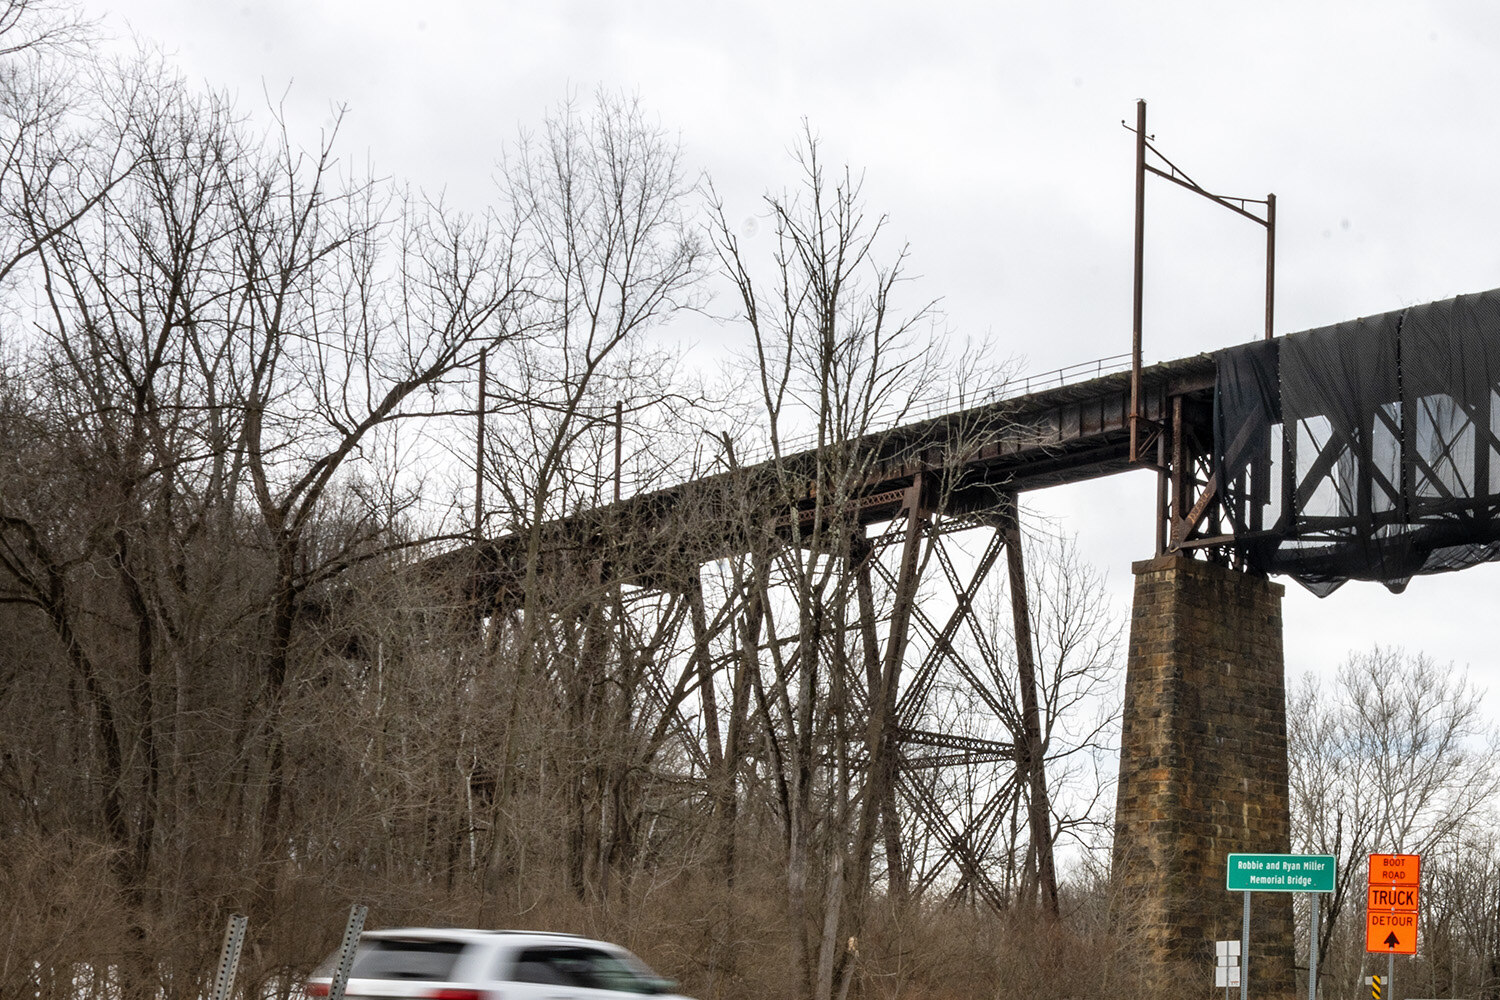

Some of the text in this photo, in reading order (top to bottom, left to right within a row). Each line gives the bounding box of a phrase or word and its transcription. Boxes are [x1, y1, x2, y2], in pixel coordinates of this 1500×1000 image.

[1238, 861, 1325, 872] Robbie and Ryan Miller
[1383, 858, 1405, 867] BOOT
[1382, 871, 1405, 879] ROAD
[1250, 875, 1312, 887] Memorial Bridge
[1372, 890, 1414, 905] TRUCK
[1372, 915, 1413, 927] DETOUR
